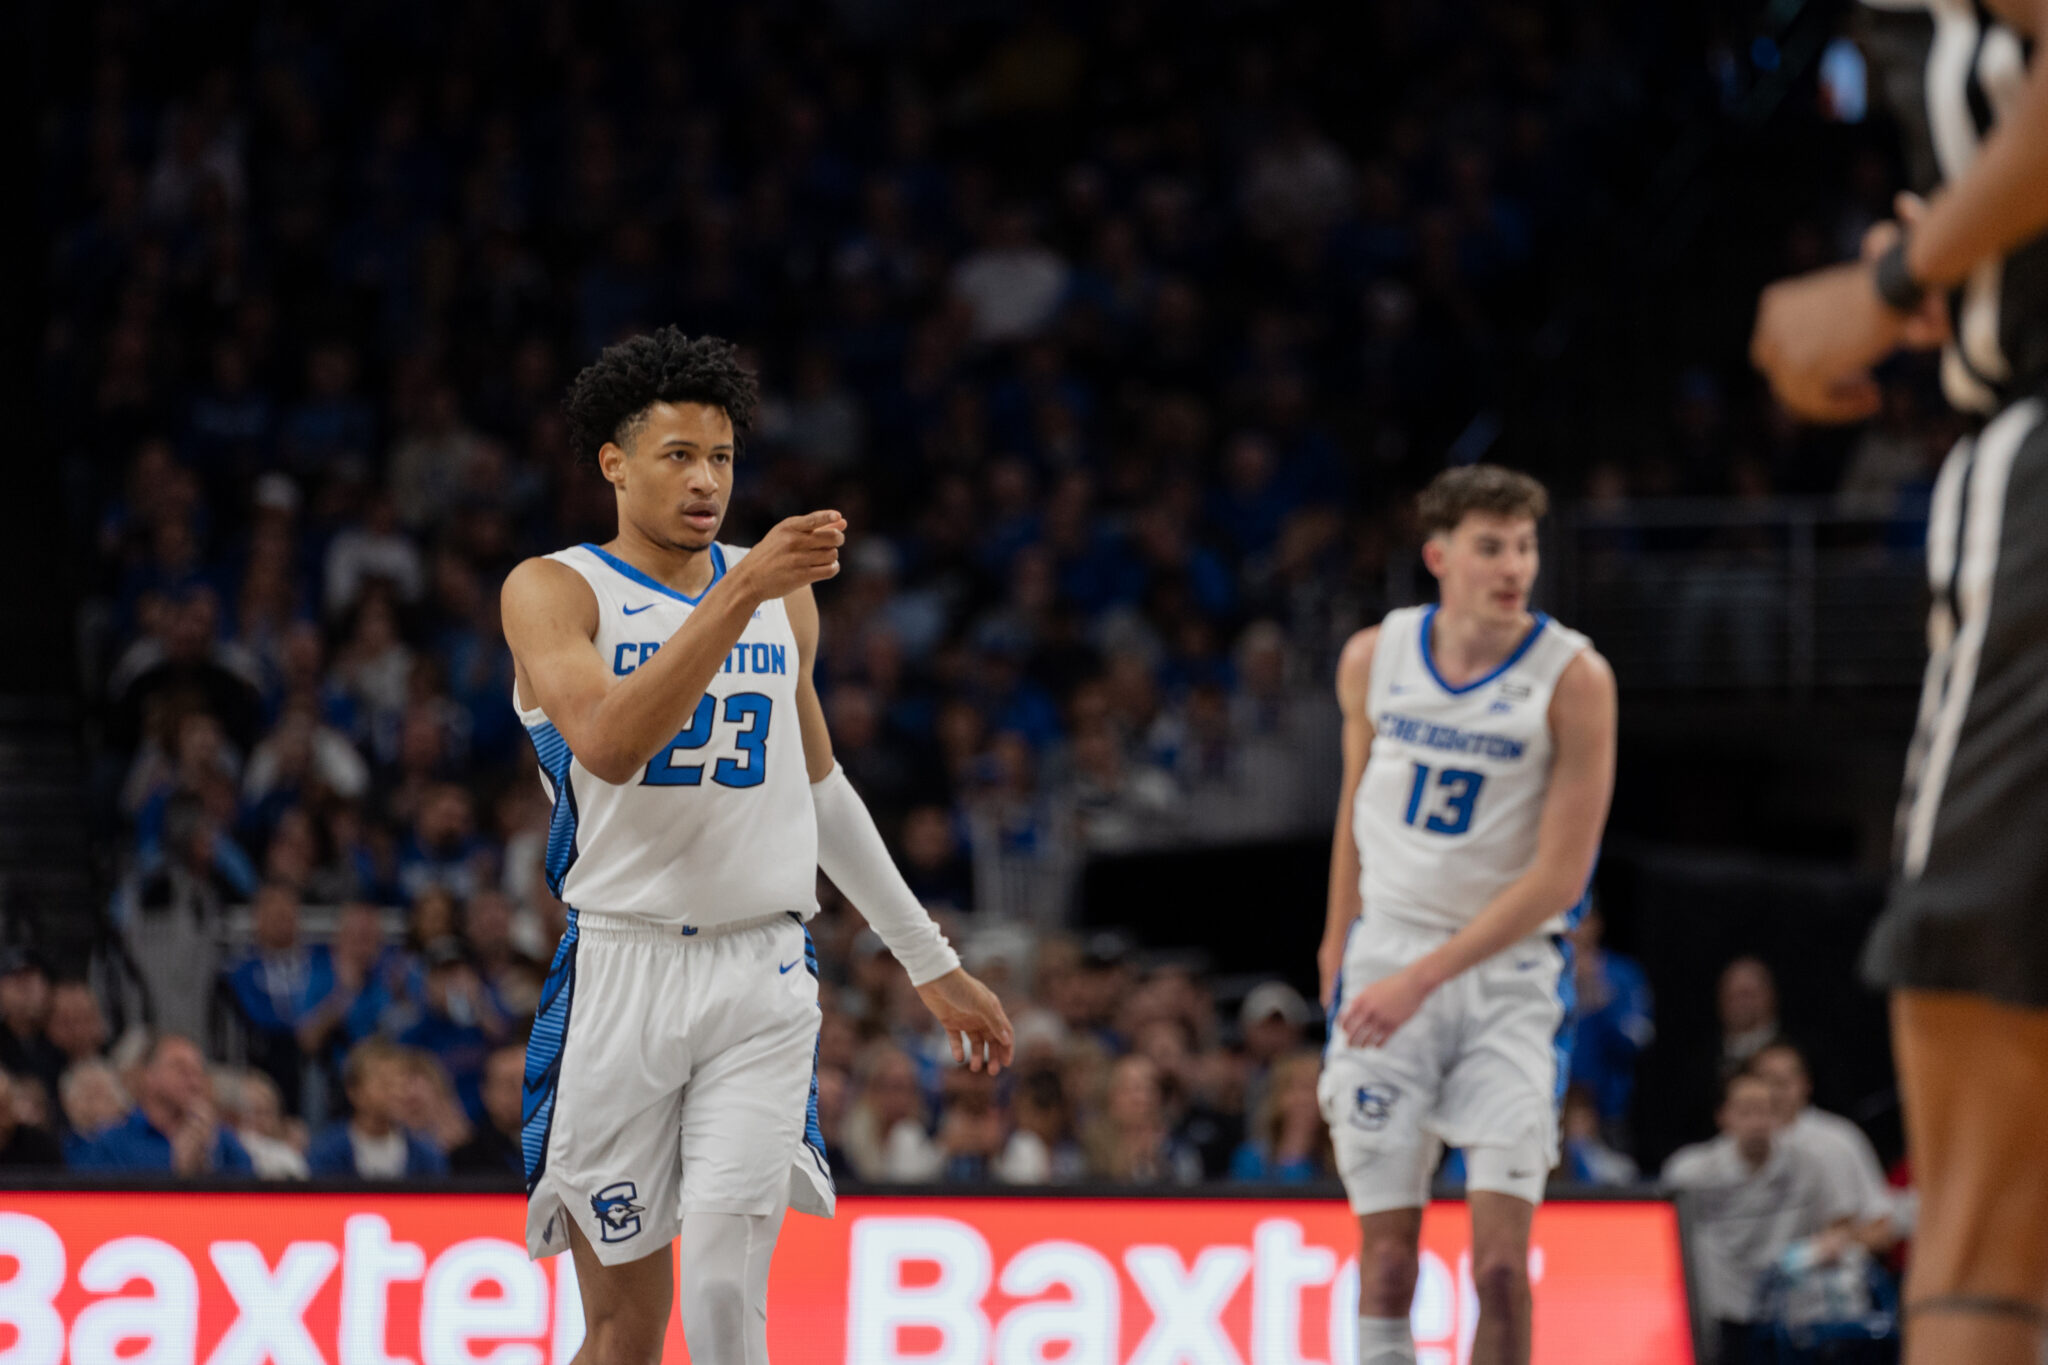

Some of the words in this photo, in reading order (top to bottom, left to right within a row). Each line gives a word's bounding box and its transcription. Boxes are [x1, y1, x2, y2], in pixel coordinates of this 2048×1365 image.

[613, 641, 786, 676] CRTON
[637, 691, 773, 788] 23
[1404, 762, 1485, 836] 13
[0, 1211, 587, 1365] axte
